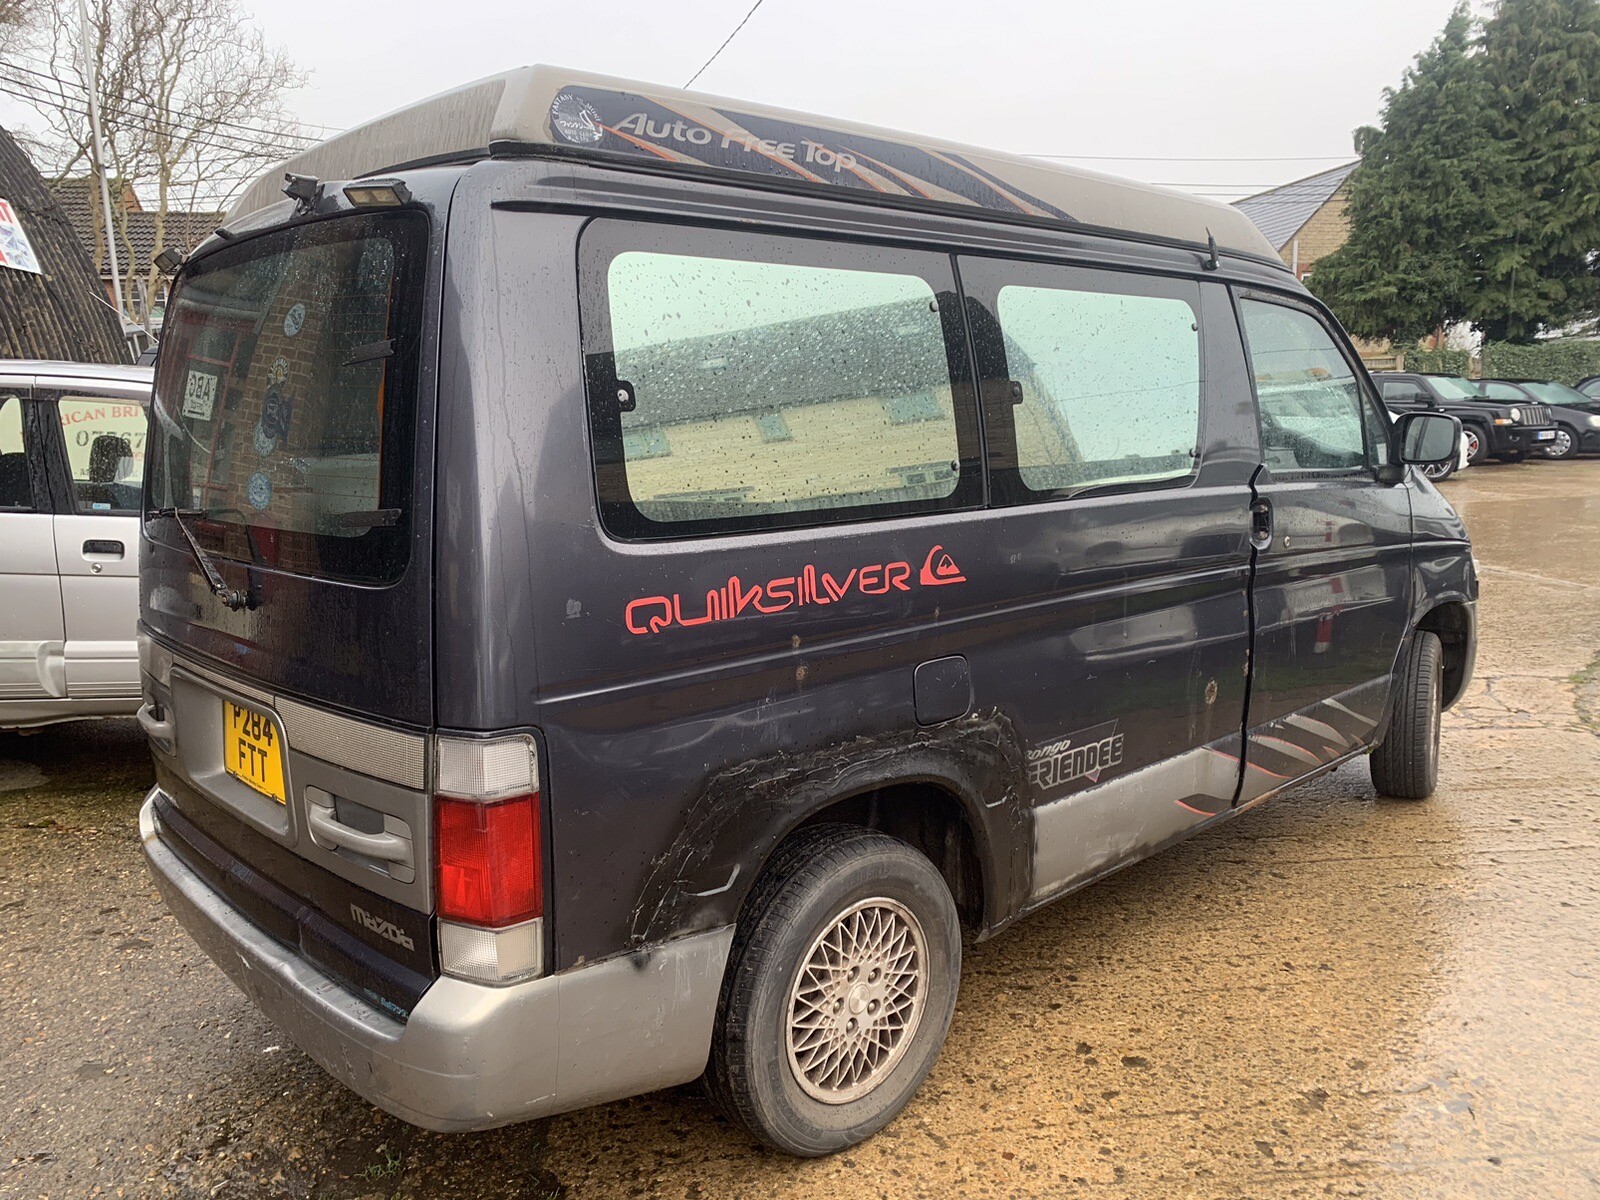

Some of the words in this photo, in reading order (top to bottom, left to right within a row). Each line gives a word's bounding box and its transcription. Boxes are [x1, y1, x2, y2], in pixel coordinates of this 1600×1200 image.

[613, 112, 712, 145] Auto
[800, 139, 857, 173] Top
[112, 405, 143, 419] BRI
[625, 561, 911, 635] QUIKSILVER
[230, 702, 273, 747] P284
[239, 737, 268, 783] FTT
[1027, 740, 1071, 760] ongo
